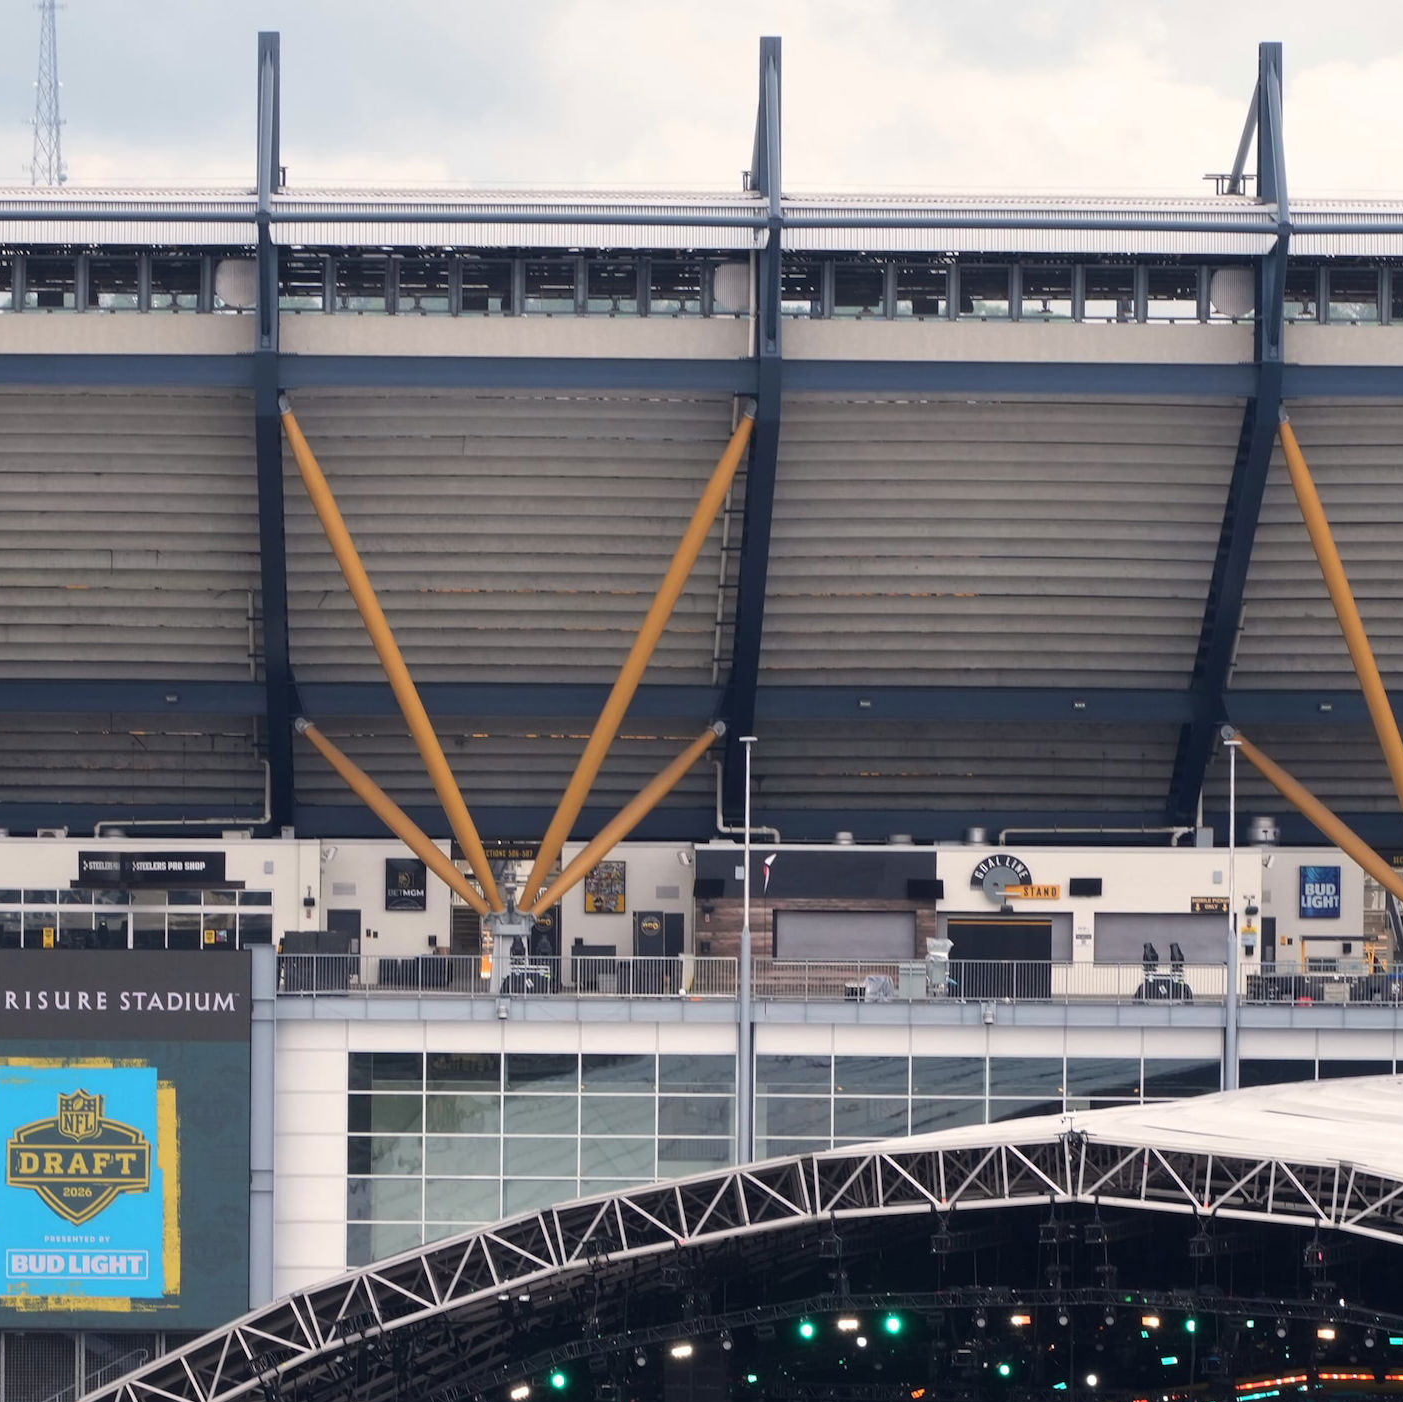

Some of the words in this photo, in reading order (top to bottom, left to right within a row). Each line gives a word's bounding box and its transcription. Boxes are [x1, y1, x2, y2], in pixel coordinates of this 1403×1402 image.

[137, 861, 166, 871] STEELERS
[168, 861, 183, 870] PRO
[184, 861, 205, 870] SHOP
[975, 856, 1001, 879] GOAL
[1006, 856, 1028, 878] LINE
[388, 888, 424, 897] BETMGM
[1023, 886, 1057, 897] STAND
[1305, 883, 1336, 895] BUD
[1301, 895, 1339, 908] LIGHT
[63, 1113, 93, 1132] NFL
[19, 1152, 137, 1174] DRAFT
[63, 1187, 92, 1197] 2026
[12, 1254, 65, 1273] BUD
[69, 1255, 143, 1274] LIGHT
